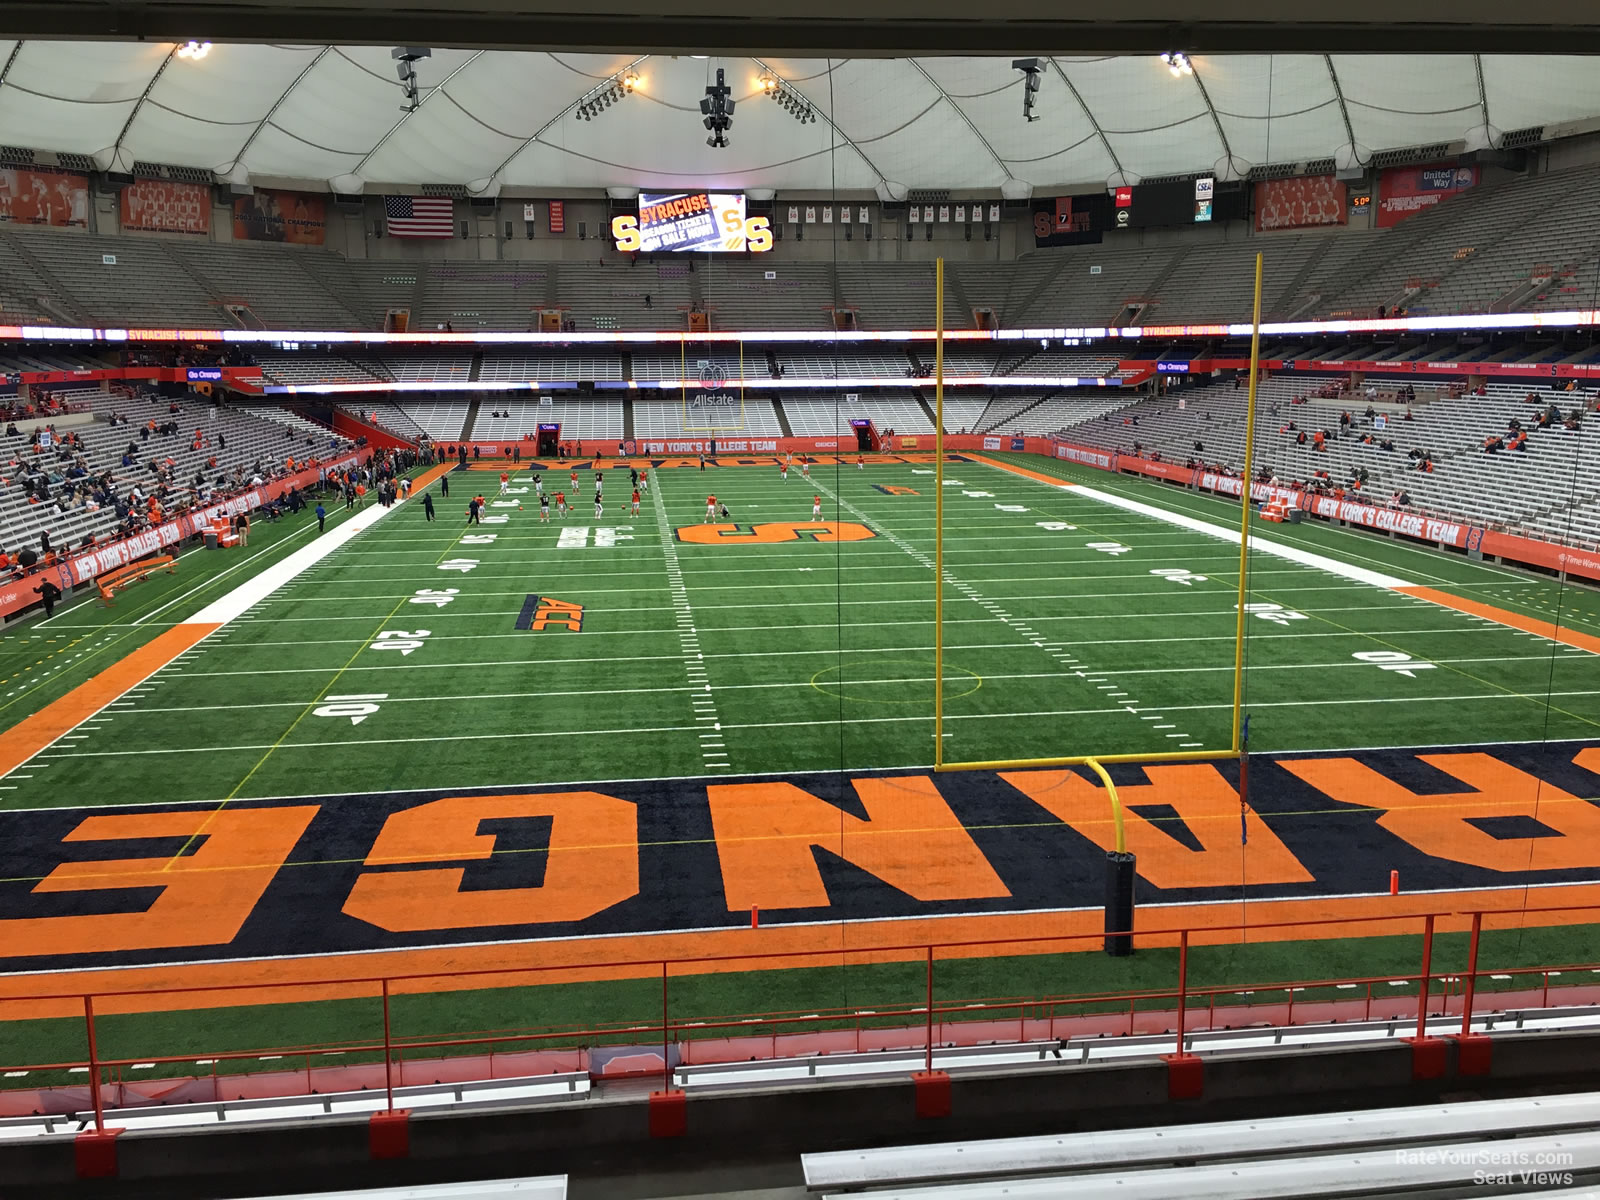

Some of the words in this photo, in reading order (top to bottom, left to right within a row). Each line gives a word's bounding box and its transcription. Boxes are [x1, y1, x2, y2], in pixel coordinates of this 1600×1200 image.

[1424, 169, 1451, 180] United
[1433, 179, 1450, 188] Way
[640, 194, 710, 223] SYRACUSE
[721, 209, 743, 232] S
[1060, 214, 1067, 223] 7
[612, 215, 641, 251] S
[661, 230, 686, 246] SALE
[745, 216, 773, 252] S
[129, 329, 178, 340] SYRACUSE
[179, 330, 223, 341] FOOTBALL
[1143, 326, 1185, 336] SYRACUSE
[1186, 325, 1228, 335] FOOTBALL
[692, 394, 734, 408] Allstate
[666, 441, 703, 452] YORK'S
[705, 441, 749, 451] CLLEGE
[750, 440, 777, 451] TEAM
[1202, 473, 1217, 488] NEW
[1218, 476, 1242, 495] YORK'S
[246, 490, 261, 509] TEAM
[1317, 497, 1339, 516] NEW
[1339, 501, 1377, 525] YORK'S
[1376, 510, 1424, 537] COLLEGE
[1425, 519, 1460, 545] TEAM
[1467, 531, 1481, 550] S
[74, 556, 98, 582] NEW
[97, 541, 129, 572] YORK'S
[128, 531, 161, 559] COLLEGE
[159, 522, 180, 546] TEAM
[1566, 554, 1583, 566] Time
[408, 588, 460, 604] 30
[369, 629, 432, 650] 20
[1351, 651, 1438, 670] 10
[312, 693, 389, 717] 10
